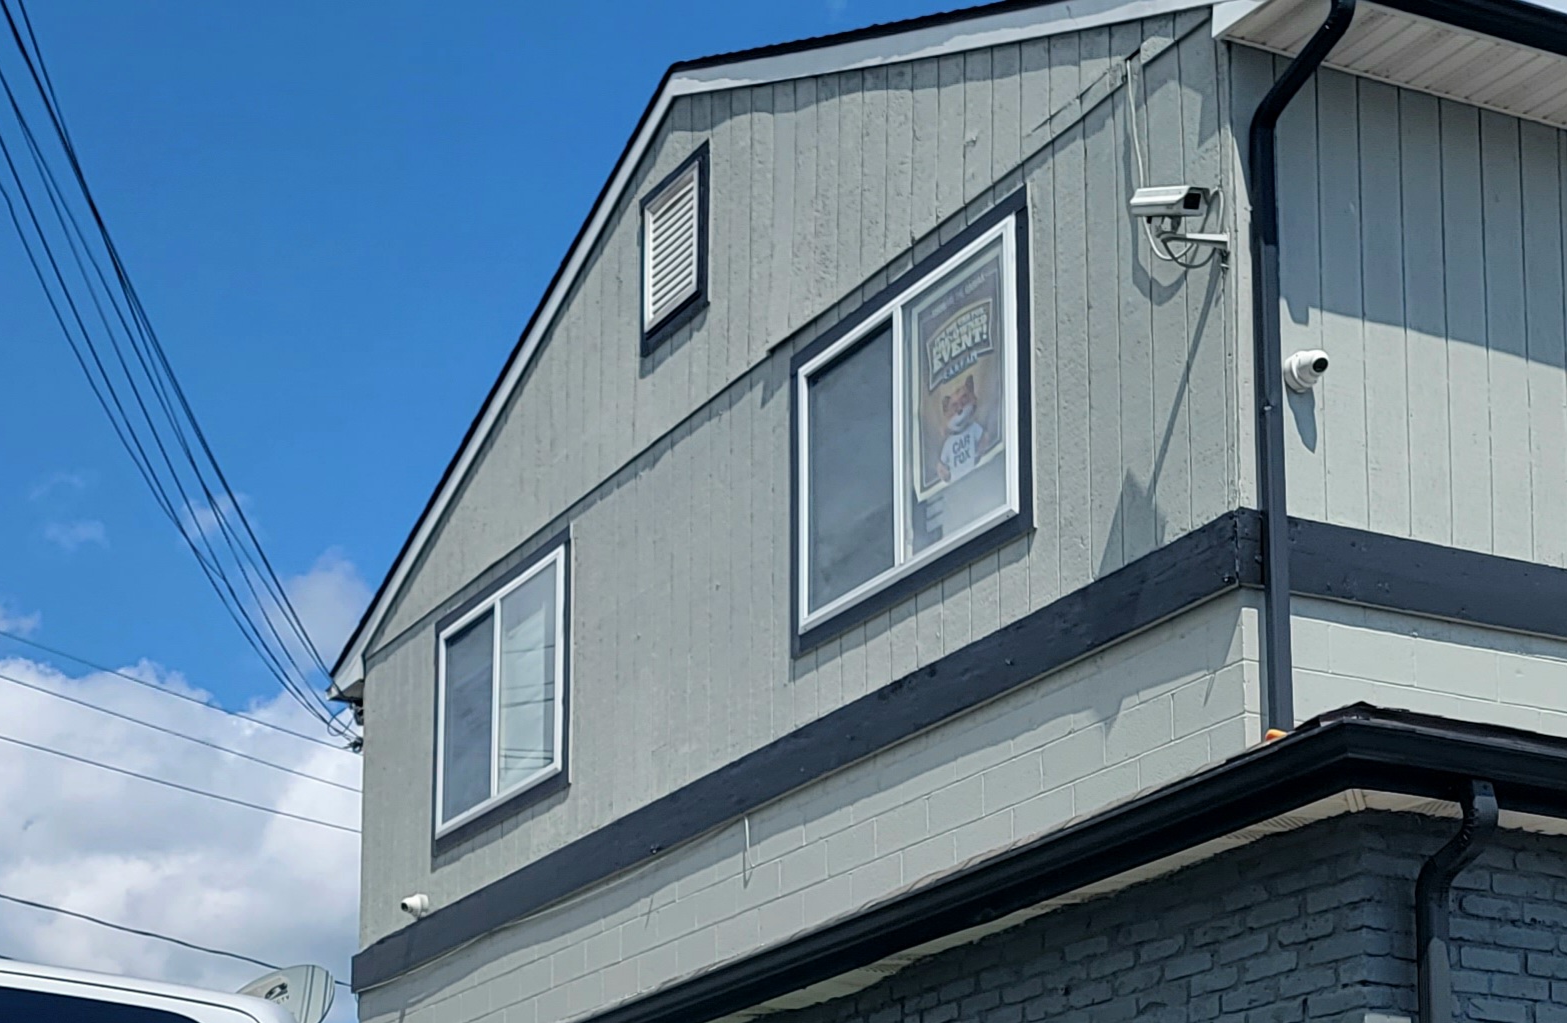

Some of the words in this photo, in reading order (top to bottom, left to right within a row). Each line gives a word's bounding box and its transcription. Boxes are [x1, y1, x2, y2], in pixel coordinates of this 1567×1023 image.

[931, 324, 988, 374] EVENT!
[952, 433, 971, 455] CAR
[953, 441, 971, 468] FOX
